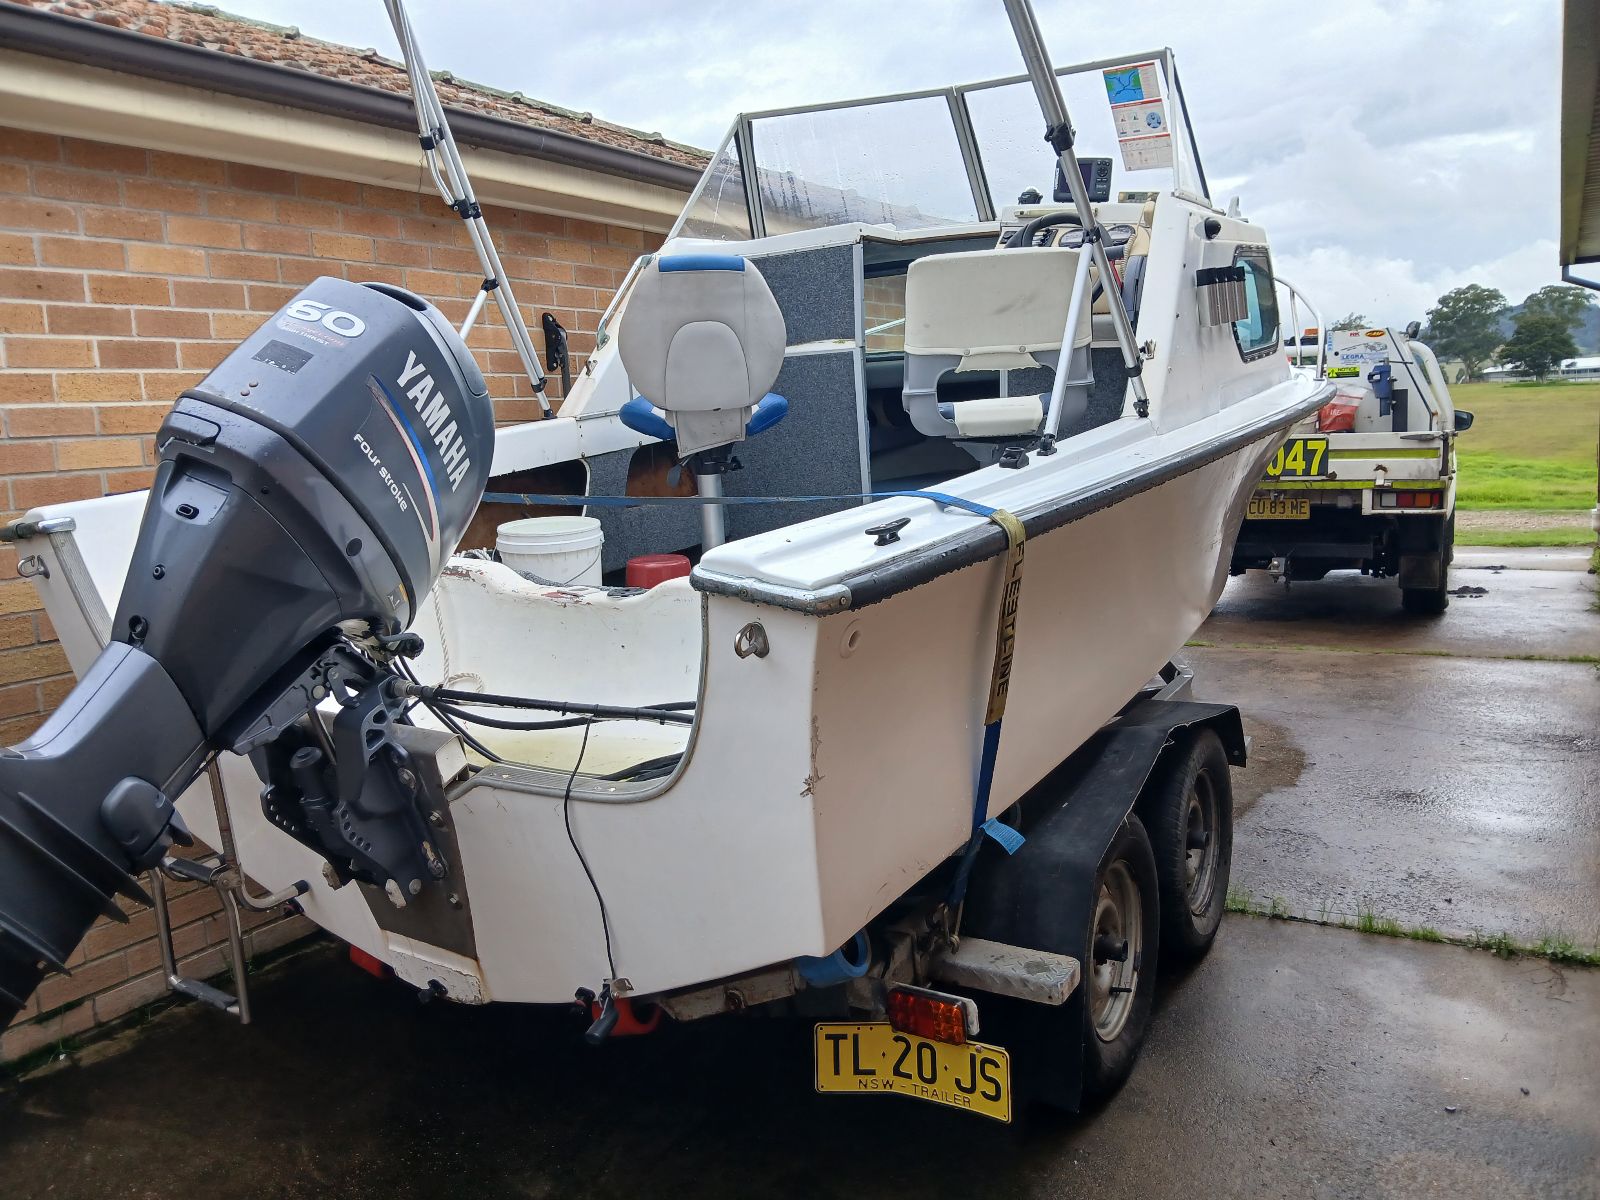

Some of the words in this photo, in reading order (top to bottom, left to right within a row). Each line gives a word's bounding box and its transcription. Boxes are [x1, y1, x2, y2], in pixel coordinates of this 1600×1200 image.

[286, 299, 366, 338] 60
[396, 350, 471, 493] YAMAHA
[1248, 501, 1265, 514] CU
[1270, 501, 1286, 514] 83
[1291, 501, 1307, 514] ME
[825, 1034, 876, 1076] TL
[892, 1035, 938, 1085] 20
[954, 1052, 1002, 1102] JS
[858, 1078, 895, 1090] NSW
[911, 1083, 972, 1108] TRAILER
